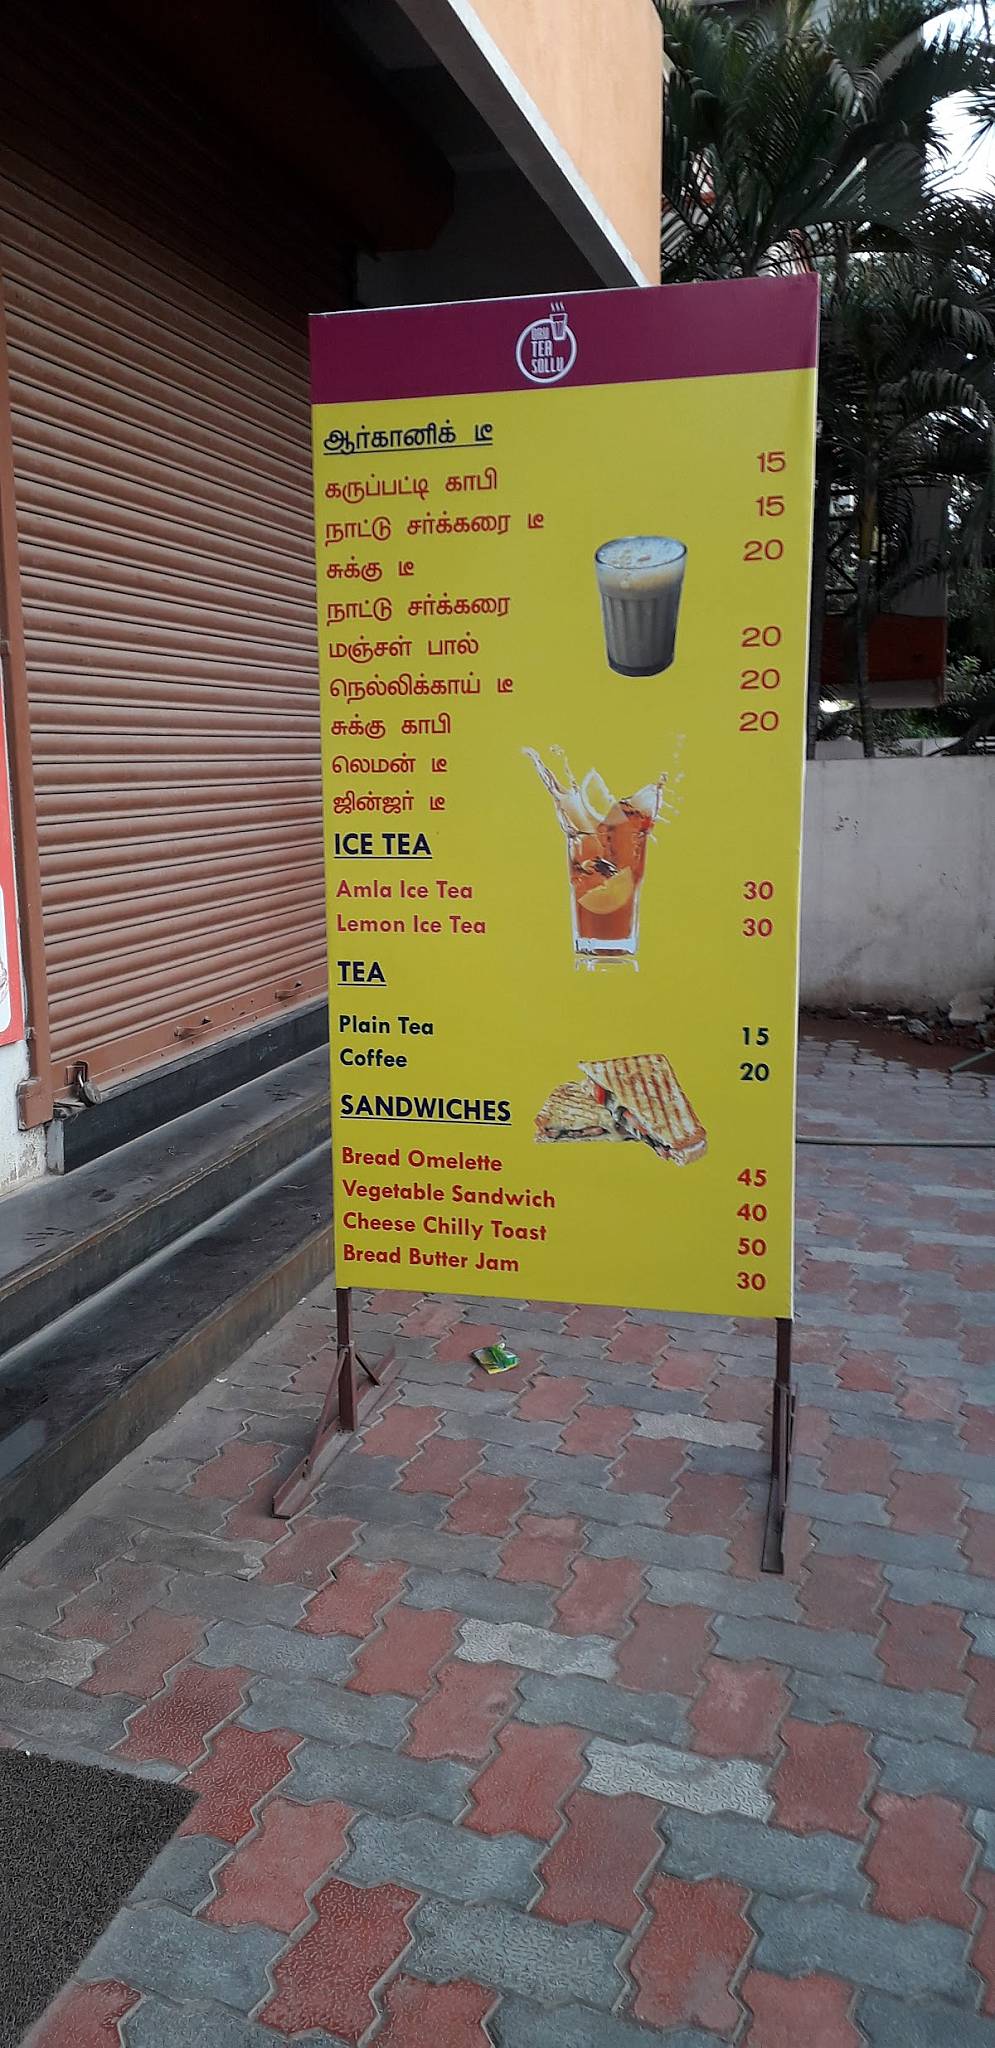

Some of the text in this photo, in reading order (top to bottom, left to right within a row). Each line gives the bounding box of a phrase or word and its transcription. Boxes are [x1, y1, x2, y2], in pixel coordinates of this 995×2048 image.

[531, 340, 552, 357] TEA
[531, 356, 564, 373] SOLLU
[324, 420, 492, 454] ஆர்கானிக் டீ
[757, 451, 786, 473] 15
[326, 468, 497, 503] கருப்பட்டி காபி
[756, 496, 784, 517] 15
[326, 512, 544, 546] நாட்டு சர்க்கரை டீ
[744, 540, 784, 562] 20
[327, 557, 414, 582] சுக்கு டீ
[327, 594, 510, 626] நாட்டு சர்க்கரை
[329, 633, 480, 663] மஞ்சள் பால்
[742, 626, 781, 648] 20
[331, 673, 513, 704] நெல்லிக்காய் டீ
[740, 669, 780, 691] 20
[332, 713, 452, 739] சுக்கு காபி
[740, 711, 780, 733] 20
[332, 753, 447, 773] லெமன் டீ
[333, 791, 445, 814] ஜின்ஜர் டீ
[334, 833, 432, 856] ICE TEA
[337, 881, 473, 899] Amla Ice Tea
[744, 881, 774, 900] 30
[337, 914, 486, 934] Lemon Ice Tea
[744, 918, 774, 937] 30
[337, 961, 386, 983] TEA
[339, 1015, 433, 1036] Plain Tea
[743, 1027, 769, 1046] 15
[340, 1048, 408, 1068] Coffee
[741, 1063, 770, 1082] 20
[341, 1094, 511, 1122] SANDWICHES
[342, 1147, 502, 1172] Bread Omelette
[738, 1169, 768, 1187] 45
[343, 1180, 556, 1208] Vegetable Sandwich
[737, 1204, 767, 1222] 40
[344, 1212, 547, 1241] Cheese Chilly Toast
[343, 1245, 519, 1272] Bread Butter Jam
[738, 1238, 767, 1257] 50
[737, 1273, 766, 1291] 30
